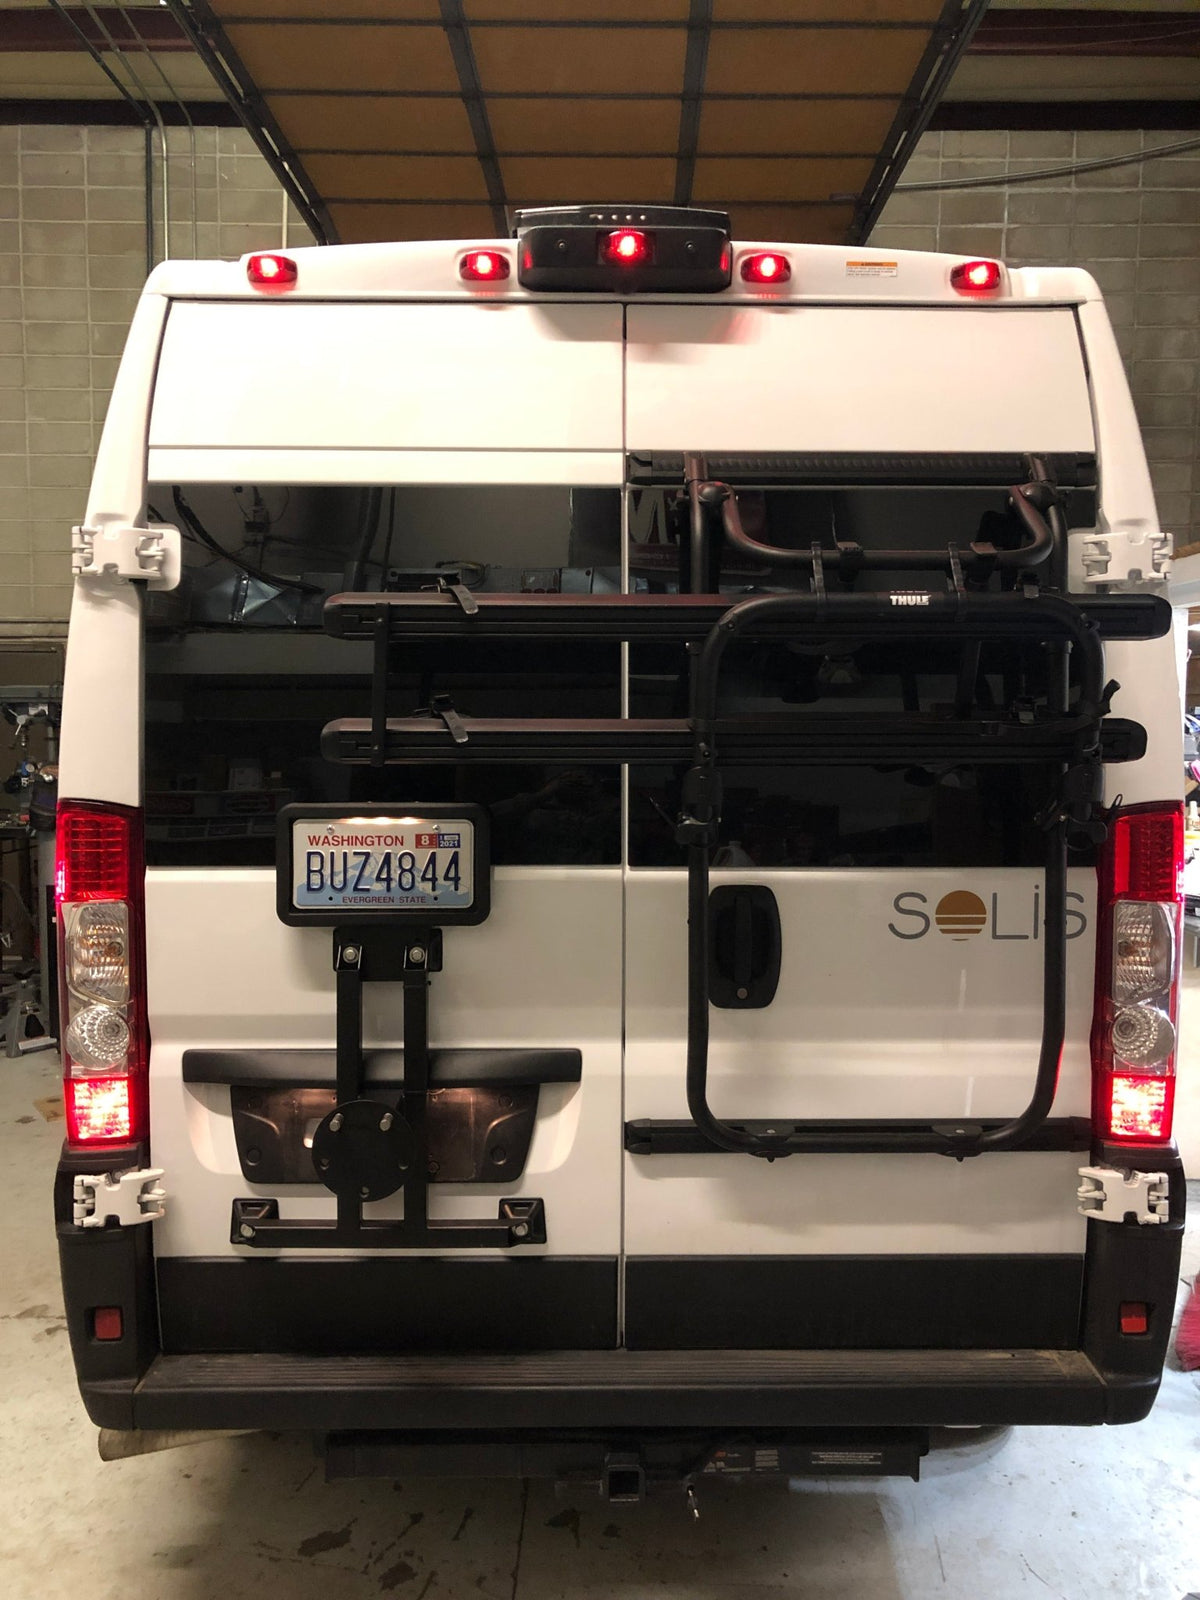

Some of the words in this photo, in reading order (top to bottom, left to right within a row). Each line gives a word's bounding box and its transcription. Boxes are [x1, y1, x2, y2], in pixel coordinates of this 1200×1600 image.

[890, 595, 930, 606] THULE
[308, 834, 405, 847] WASHINGTON
[421, 834, 430, 846] 8
[439, 840, 459, 848] 2021
[306, 850, 462, 893] BUZ4844
[342, 895, 395, 904] EVERGREEN
[399, 895, 427, 904] STATE
